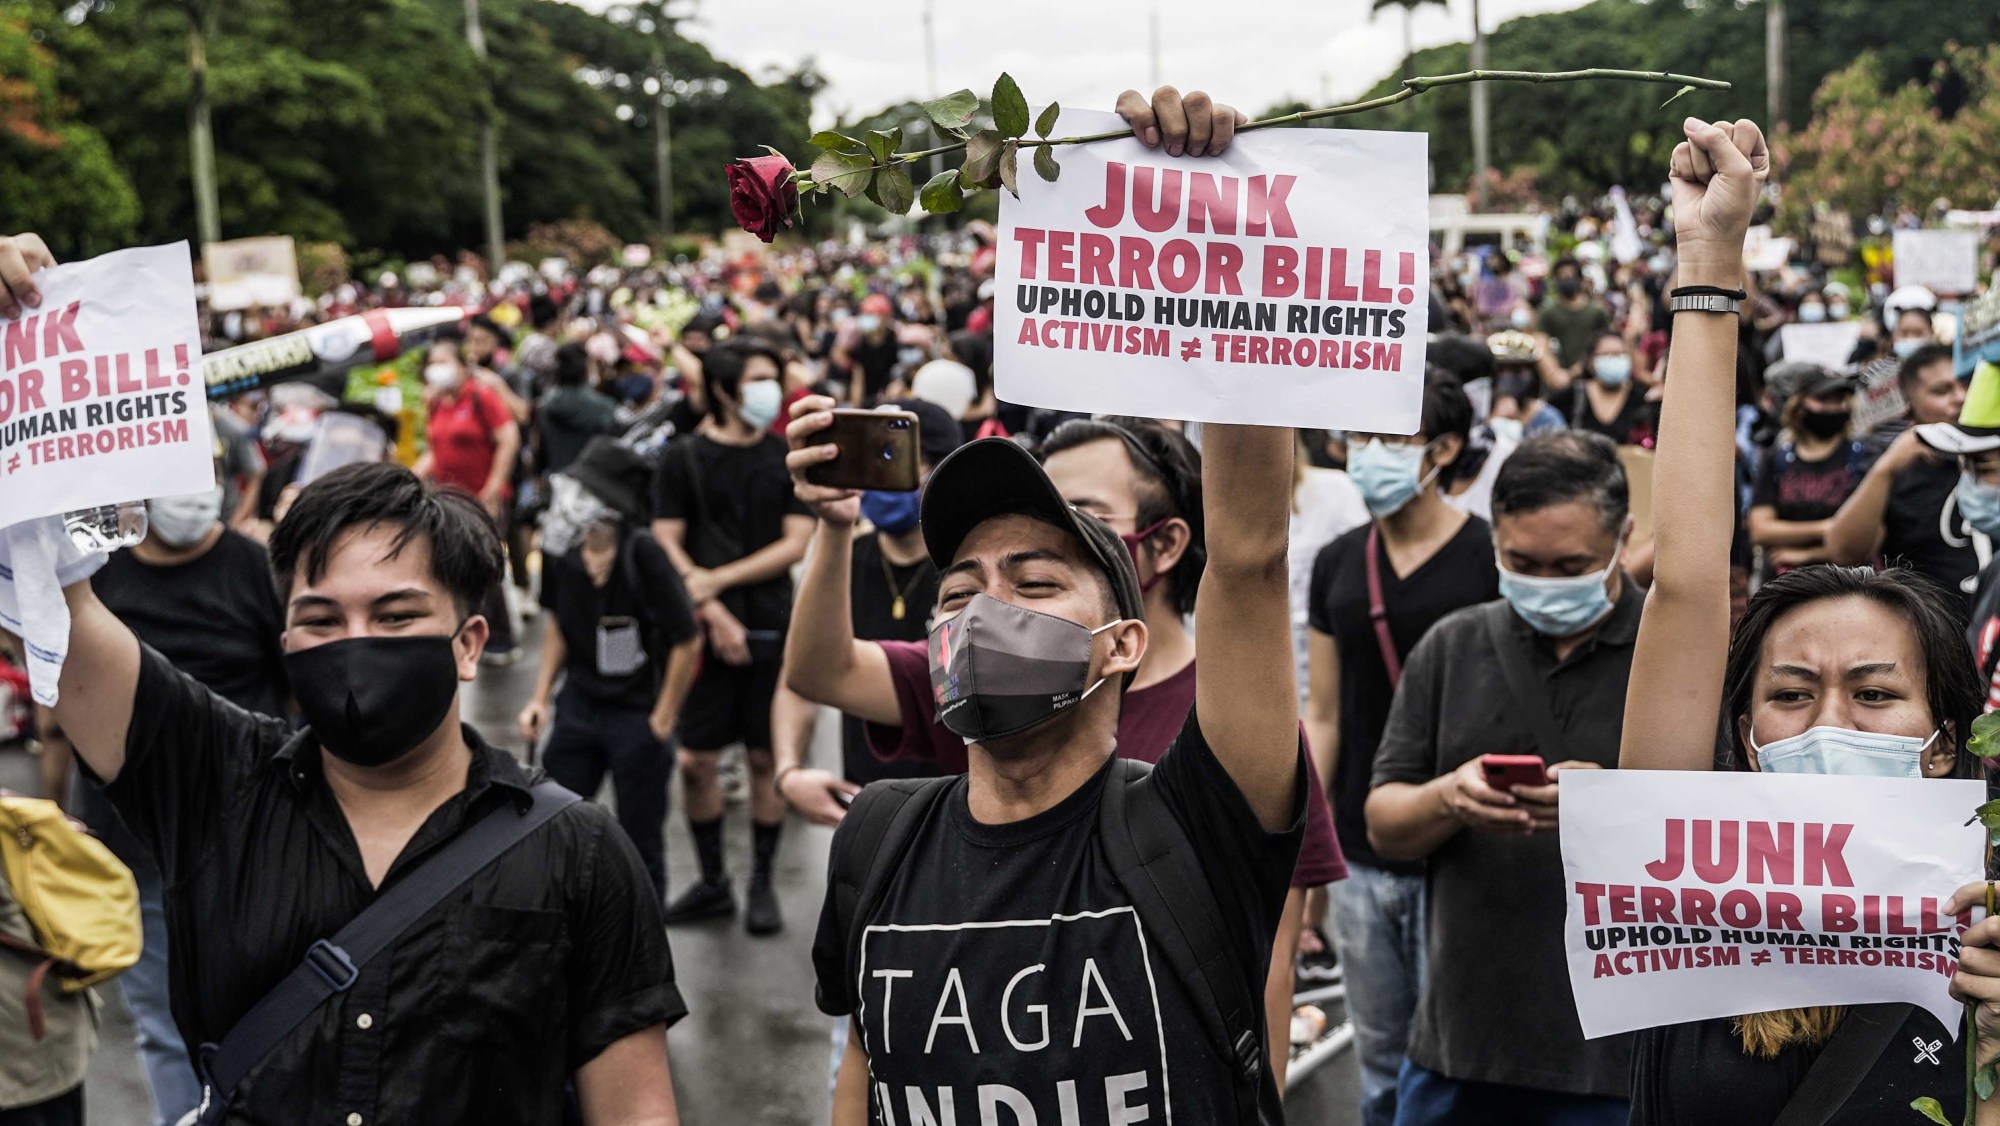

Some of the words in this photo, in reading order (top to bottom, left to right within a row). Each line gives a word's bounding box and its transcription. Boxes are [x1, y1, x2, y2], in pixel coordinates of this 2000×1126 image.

[1084, 161, 1298, 239] JUNK
[1013, 227, 1244, 296] TERROR
[1261, 244, 1415, 305] BILL!
[0, 300, 85, 372] NK
[1016, 285, 1145, 321] UPHOLD
[1154, 296, 1276, 332] HUMAN
[1287, 305, 1406, 339] RIGHTS
[1017, 318, 1170, 357] ACTIVISM
[1211, 333, 1402, 372] TERRORISM
[60, 343, 190, 403] BILL!
[86, 391, 187, 427] RIGHTS
[28, 418, 189, 466] TERRORISM
[1052, 692, 1070, 702] MASK
[1644, 818, 1854, 887] JUNK
[1575, 882, 1804, 932] TERROR
[1585, 926, 1713, 951] UPHOLD
[1721, 929, 1840, 948] HUMAN
[1850, 935, 1962, 960] RIGHTS
[1593, 946, 1740, 979] ACTIVISM
[1784, 947, 1959, 979] TERRORISM
[872, 957, 1133, 1054] TAGA
